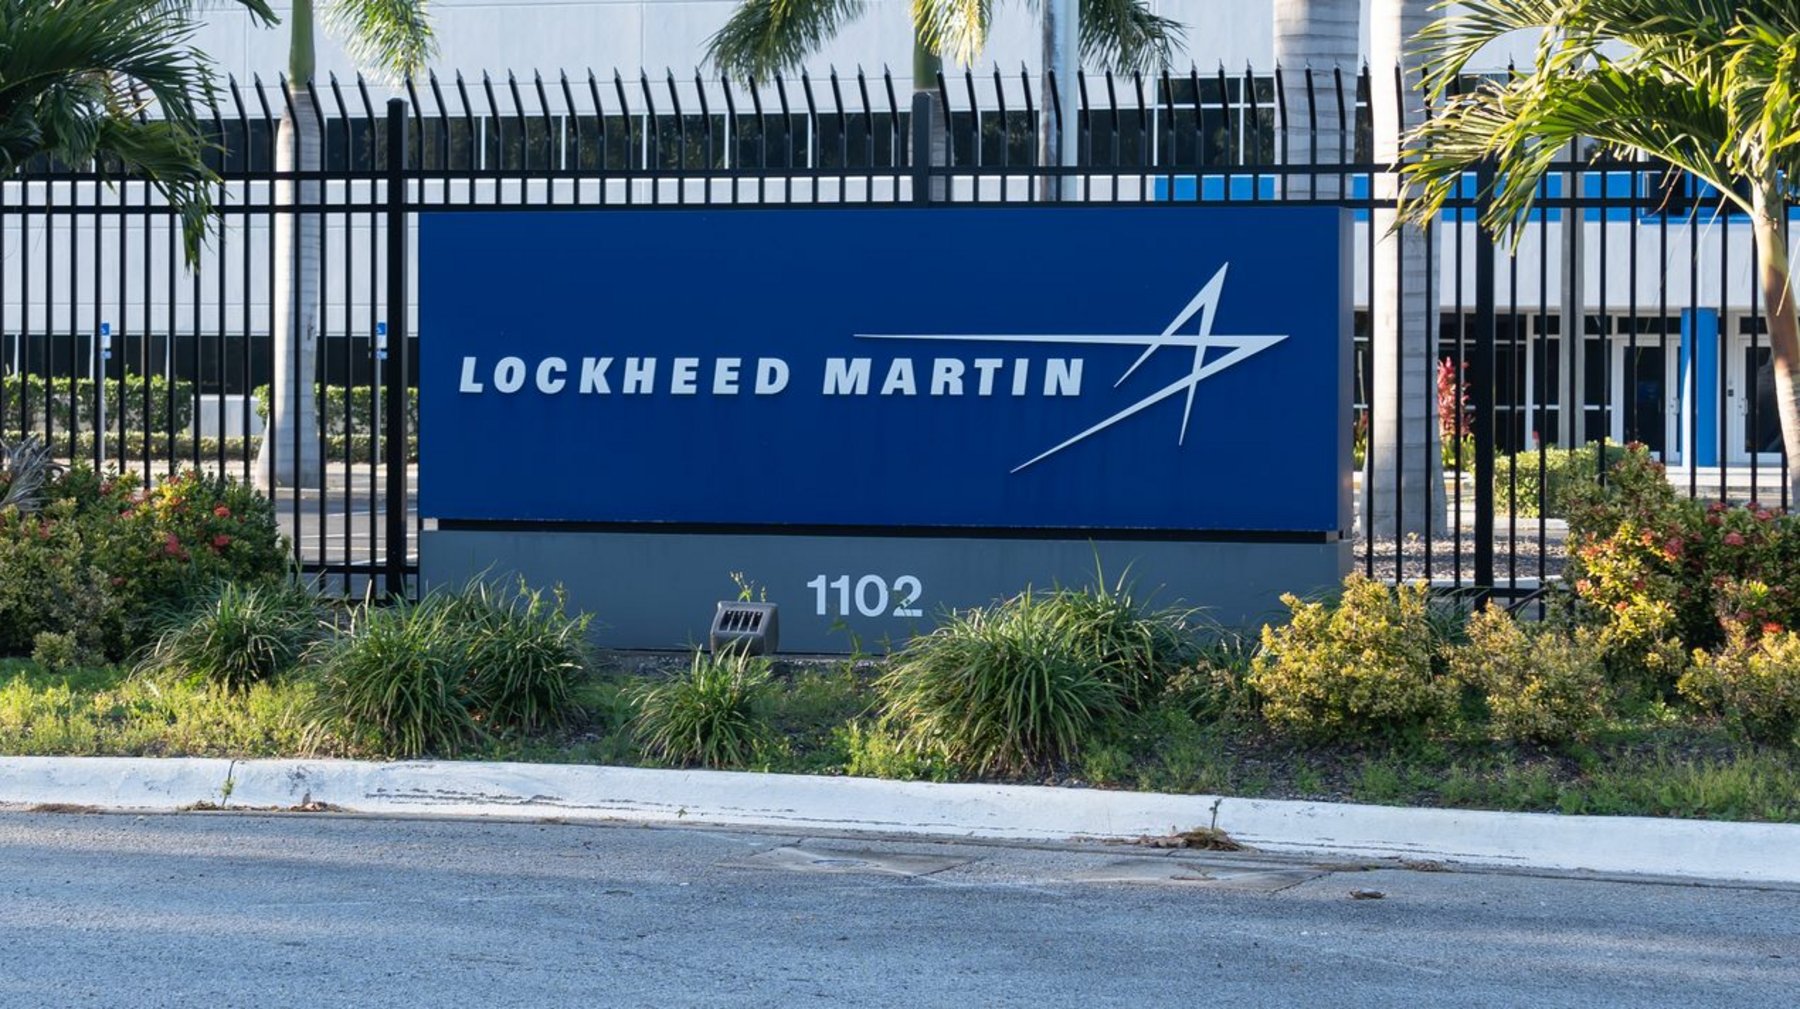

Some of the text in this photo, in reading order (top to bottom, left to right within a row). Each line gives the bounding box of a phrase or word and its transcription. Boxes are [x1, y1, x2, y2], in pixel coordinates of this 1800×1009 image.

[459, 356, 1084, 397] LOCKHEED MARTIN
[806, 574, 923, 618] 1102
